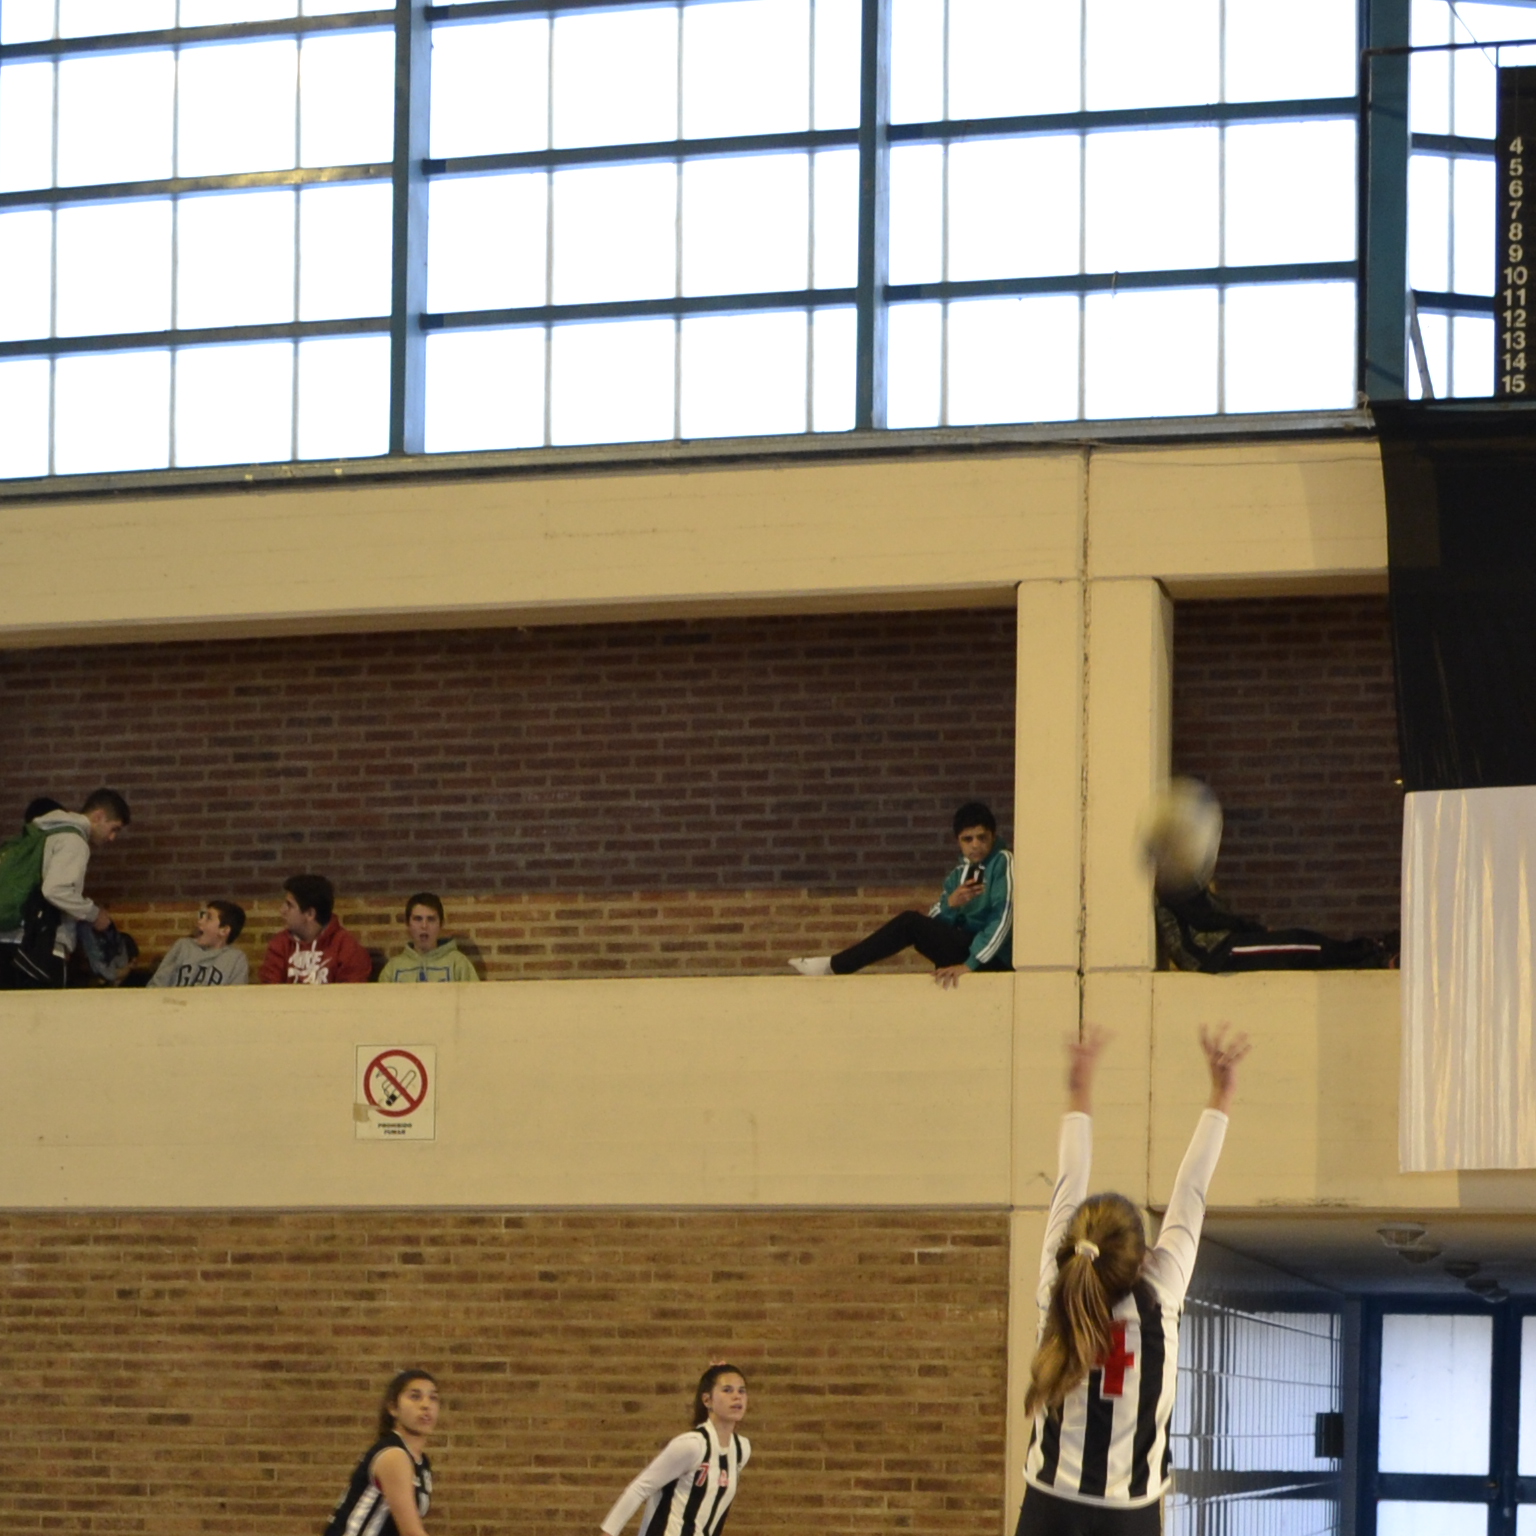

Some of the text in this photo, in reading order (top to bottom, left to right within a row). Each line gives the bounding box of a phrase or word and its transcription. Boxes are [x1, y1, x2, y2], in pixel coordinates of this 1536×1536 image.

[1510, 136, 1524, 155] 4
[1509, 158, 1524, 177] 5
[1508, 180, 1524, 198] 6
[1508, 201, 1523, 220] 7
[1508, 222, 1523, 241] 8
[1508, 244, 1524, 263] 9
[1504, 266, 1528, 285] 10
[1503, 288, 1526, 307] 11
[1503, 309, 1527, 328] 12
[1502, 331, 1526, 350] 13
[1503, 352, 1527, 371] 14
[1502, 374, 1526, 393] 15
[176, 964, 223, 987] GAP
